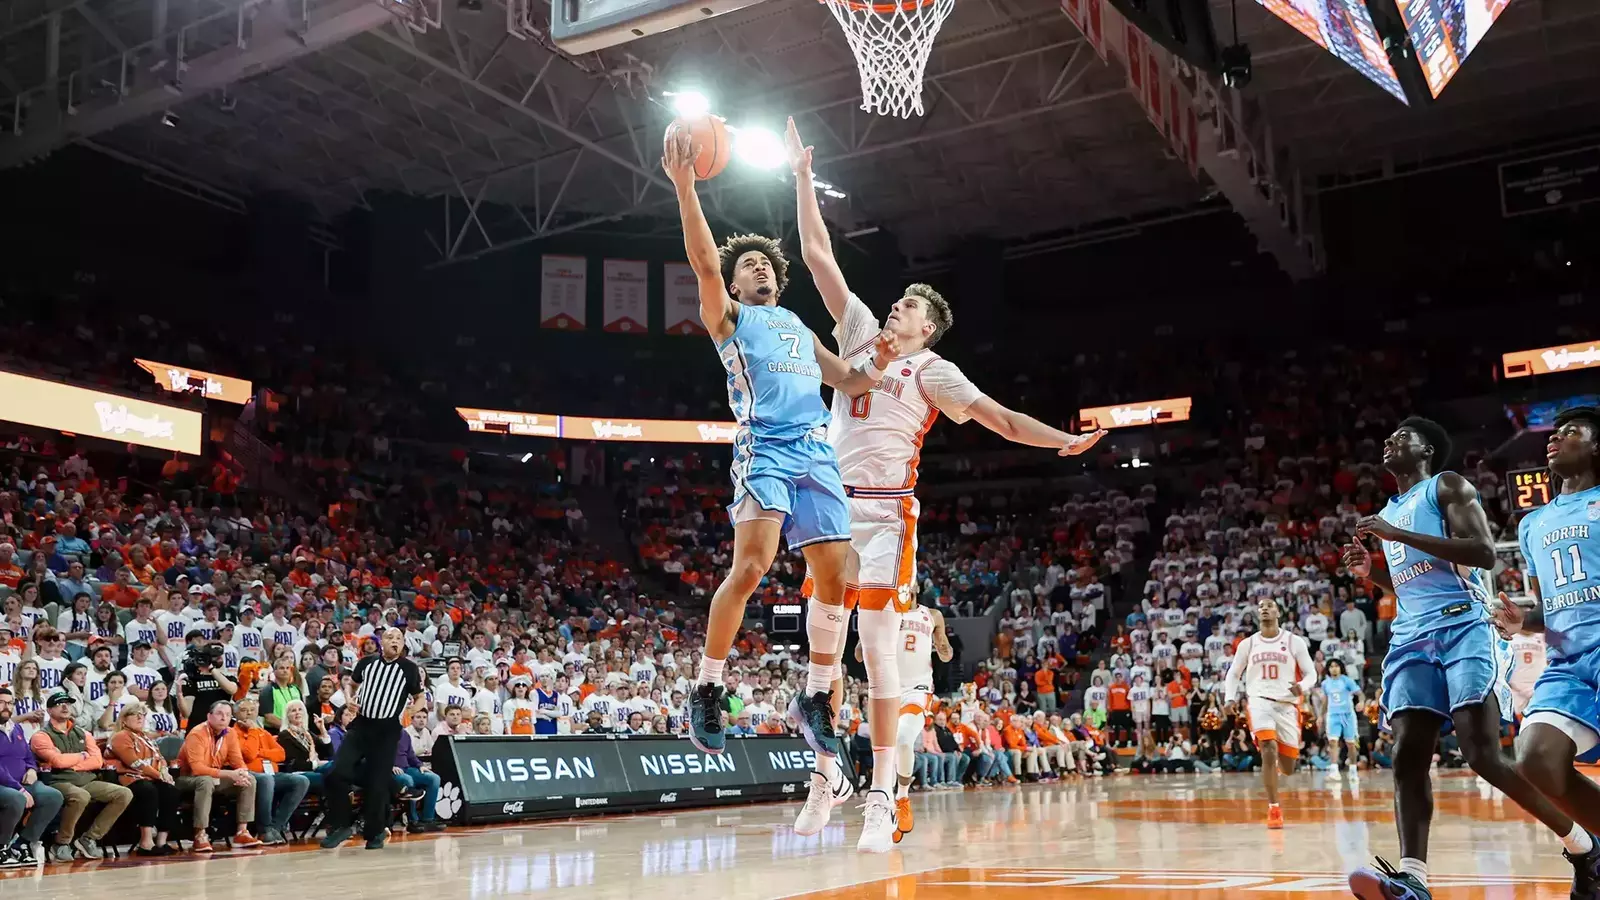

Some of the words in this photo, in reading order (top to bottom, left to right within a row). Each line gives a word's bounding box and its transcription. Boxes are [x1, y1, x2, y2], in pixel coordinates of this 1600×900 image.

[1424, 33, 1441, 57] 15
[778, 333, 801, 360] 7
[849, 391, 873, 421] 0
[1518, 484, 1549, 507] 27
[1542, 525, 1589, 549] NORTH
[1391, 559, 1433, 588] ROLINA
[1551, 543, 1588, 588] 11
[1543, 585, 1600, 611] CAROLIN
[904, 634, 917, 652] 2
[1262, 664, 1279, 680] 10
[15, 696, 39, 716] BEA
[152, 714, 173, 733] BEA
[470, 757, 596, 783] NISSAN
[640, 752, 736, 776] NISSAN
